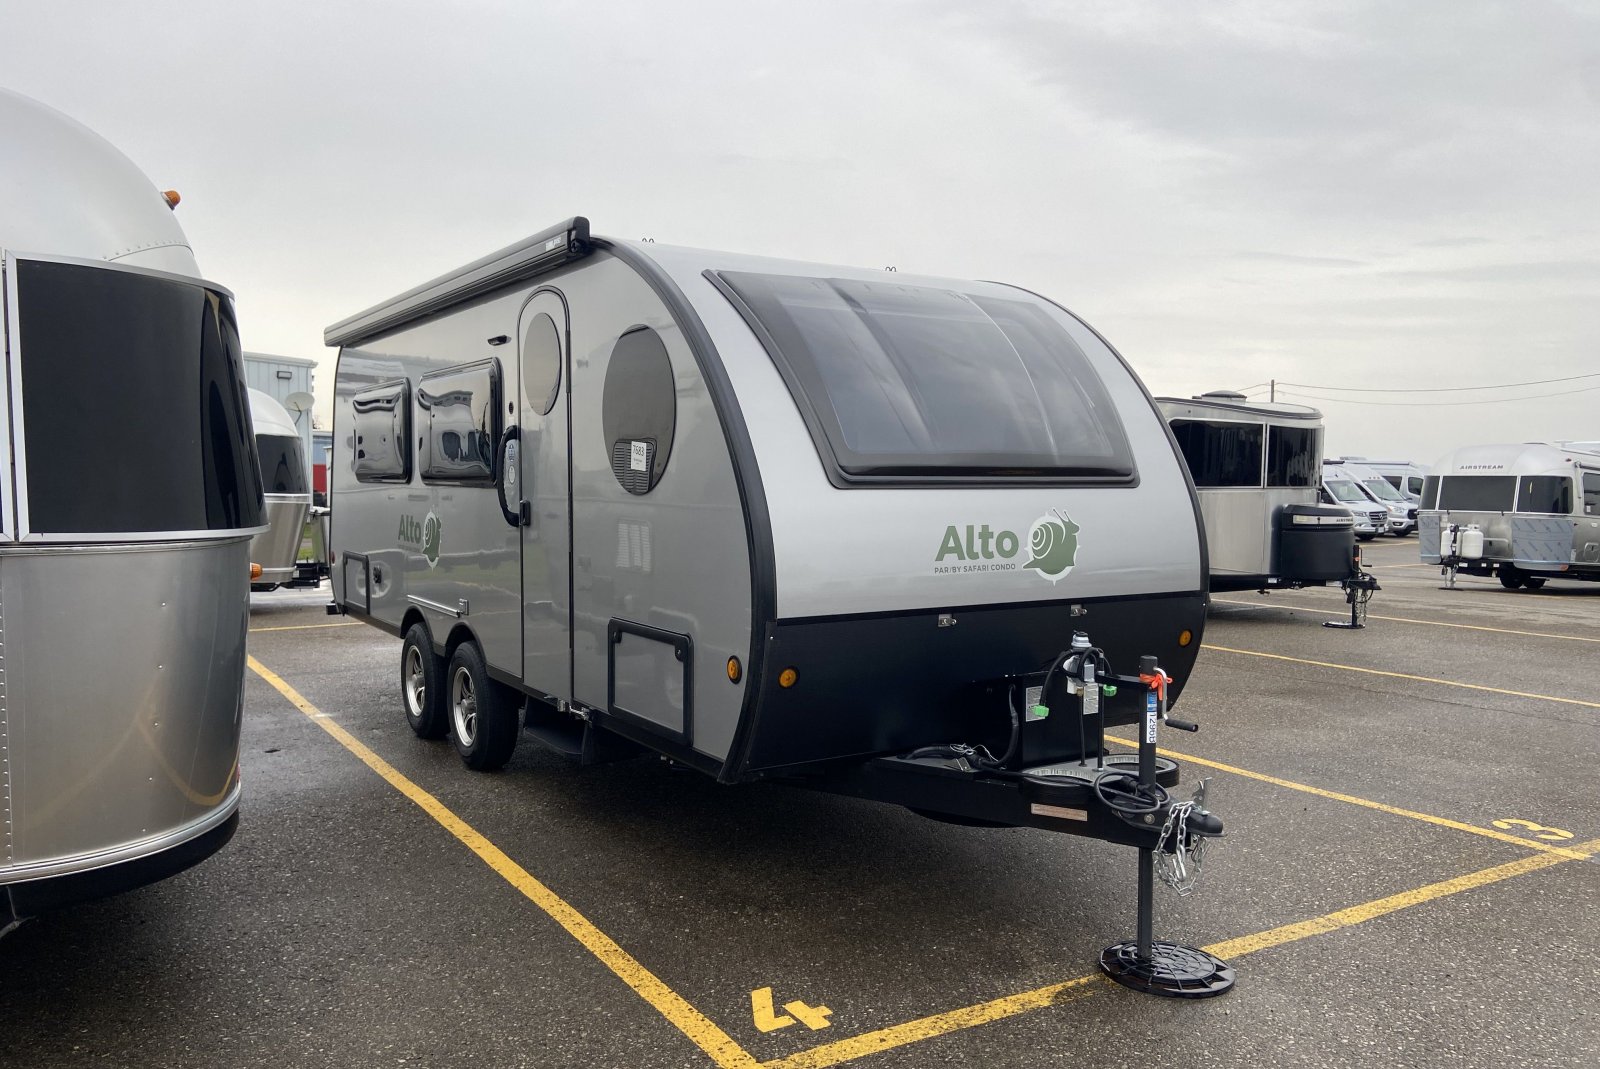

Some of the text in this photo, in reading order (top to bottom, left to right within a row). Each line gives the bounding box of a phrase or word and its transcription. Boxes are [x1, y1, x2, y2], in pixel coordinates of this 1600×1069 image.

[398, 514, 421, 544] Alto
[935, 525, 1019, 562] Alto
[963, 565, 989, 573] SAFARI
[990, 563, 1016, 571] CONDO
[752, 986, 833, 1033] 4
